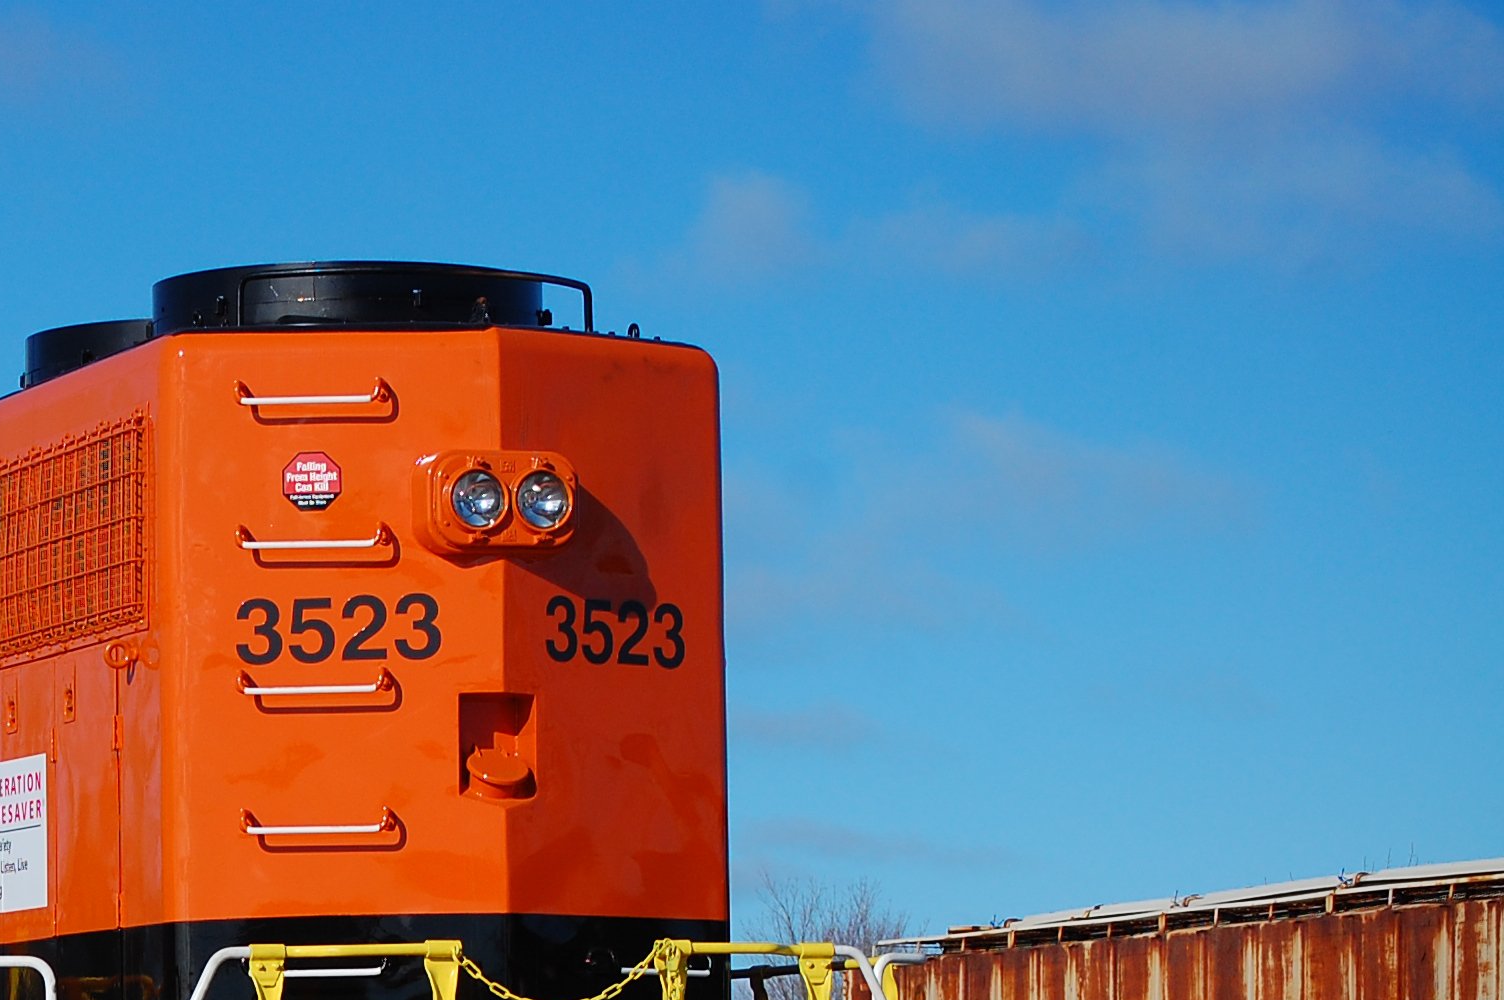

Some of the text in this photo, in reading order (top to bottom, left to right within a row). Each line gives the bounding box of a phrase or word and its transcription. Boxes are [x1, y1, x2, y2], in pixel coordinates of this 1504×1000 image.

[296, 461, 327, 473] Falling
[286, 471, 337, 483] From Height
[295, 481, 329, 492] Can Kill
[235, 592, 442, 666] 3523
[545, 594, 686, 670] 3523
[17, 857, 28, 871] Live
